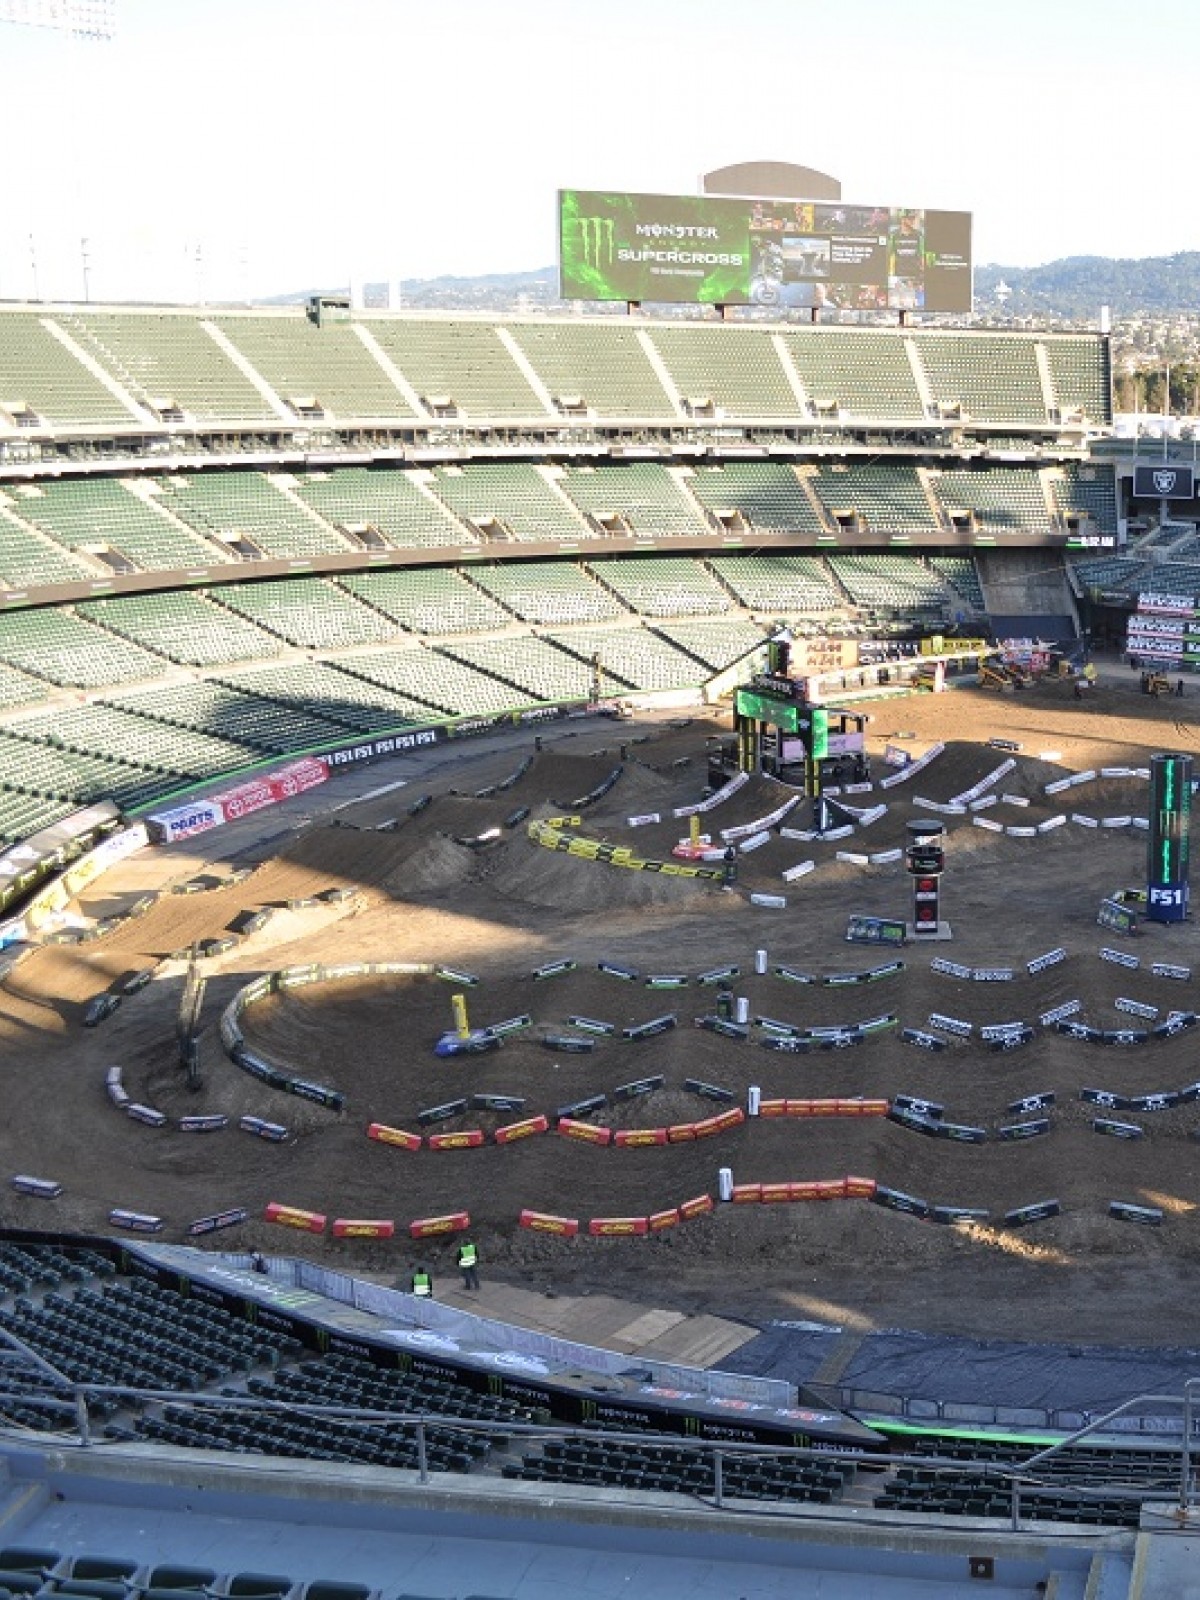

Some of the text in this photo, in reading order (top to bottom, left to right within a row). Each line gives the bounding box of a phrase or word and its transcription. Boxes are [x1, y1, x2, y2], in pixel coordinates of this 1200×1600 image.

[636, 223, 719, 239] MONSTER
[618, 247, 743, 266] SUPERCROSS
[395, 734, 415, 749] FS1
[416, 730, 437, 745] FS1
[355, 744, 373, 759] FS1
[375, 739, 394, 753] FS1
[335, 750, 353, 765] FS1
[171, 809, 215, 830] PARTS
[1151, 889, 1182, 906] FS1
